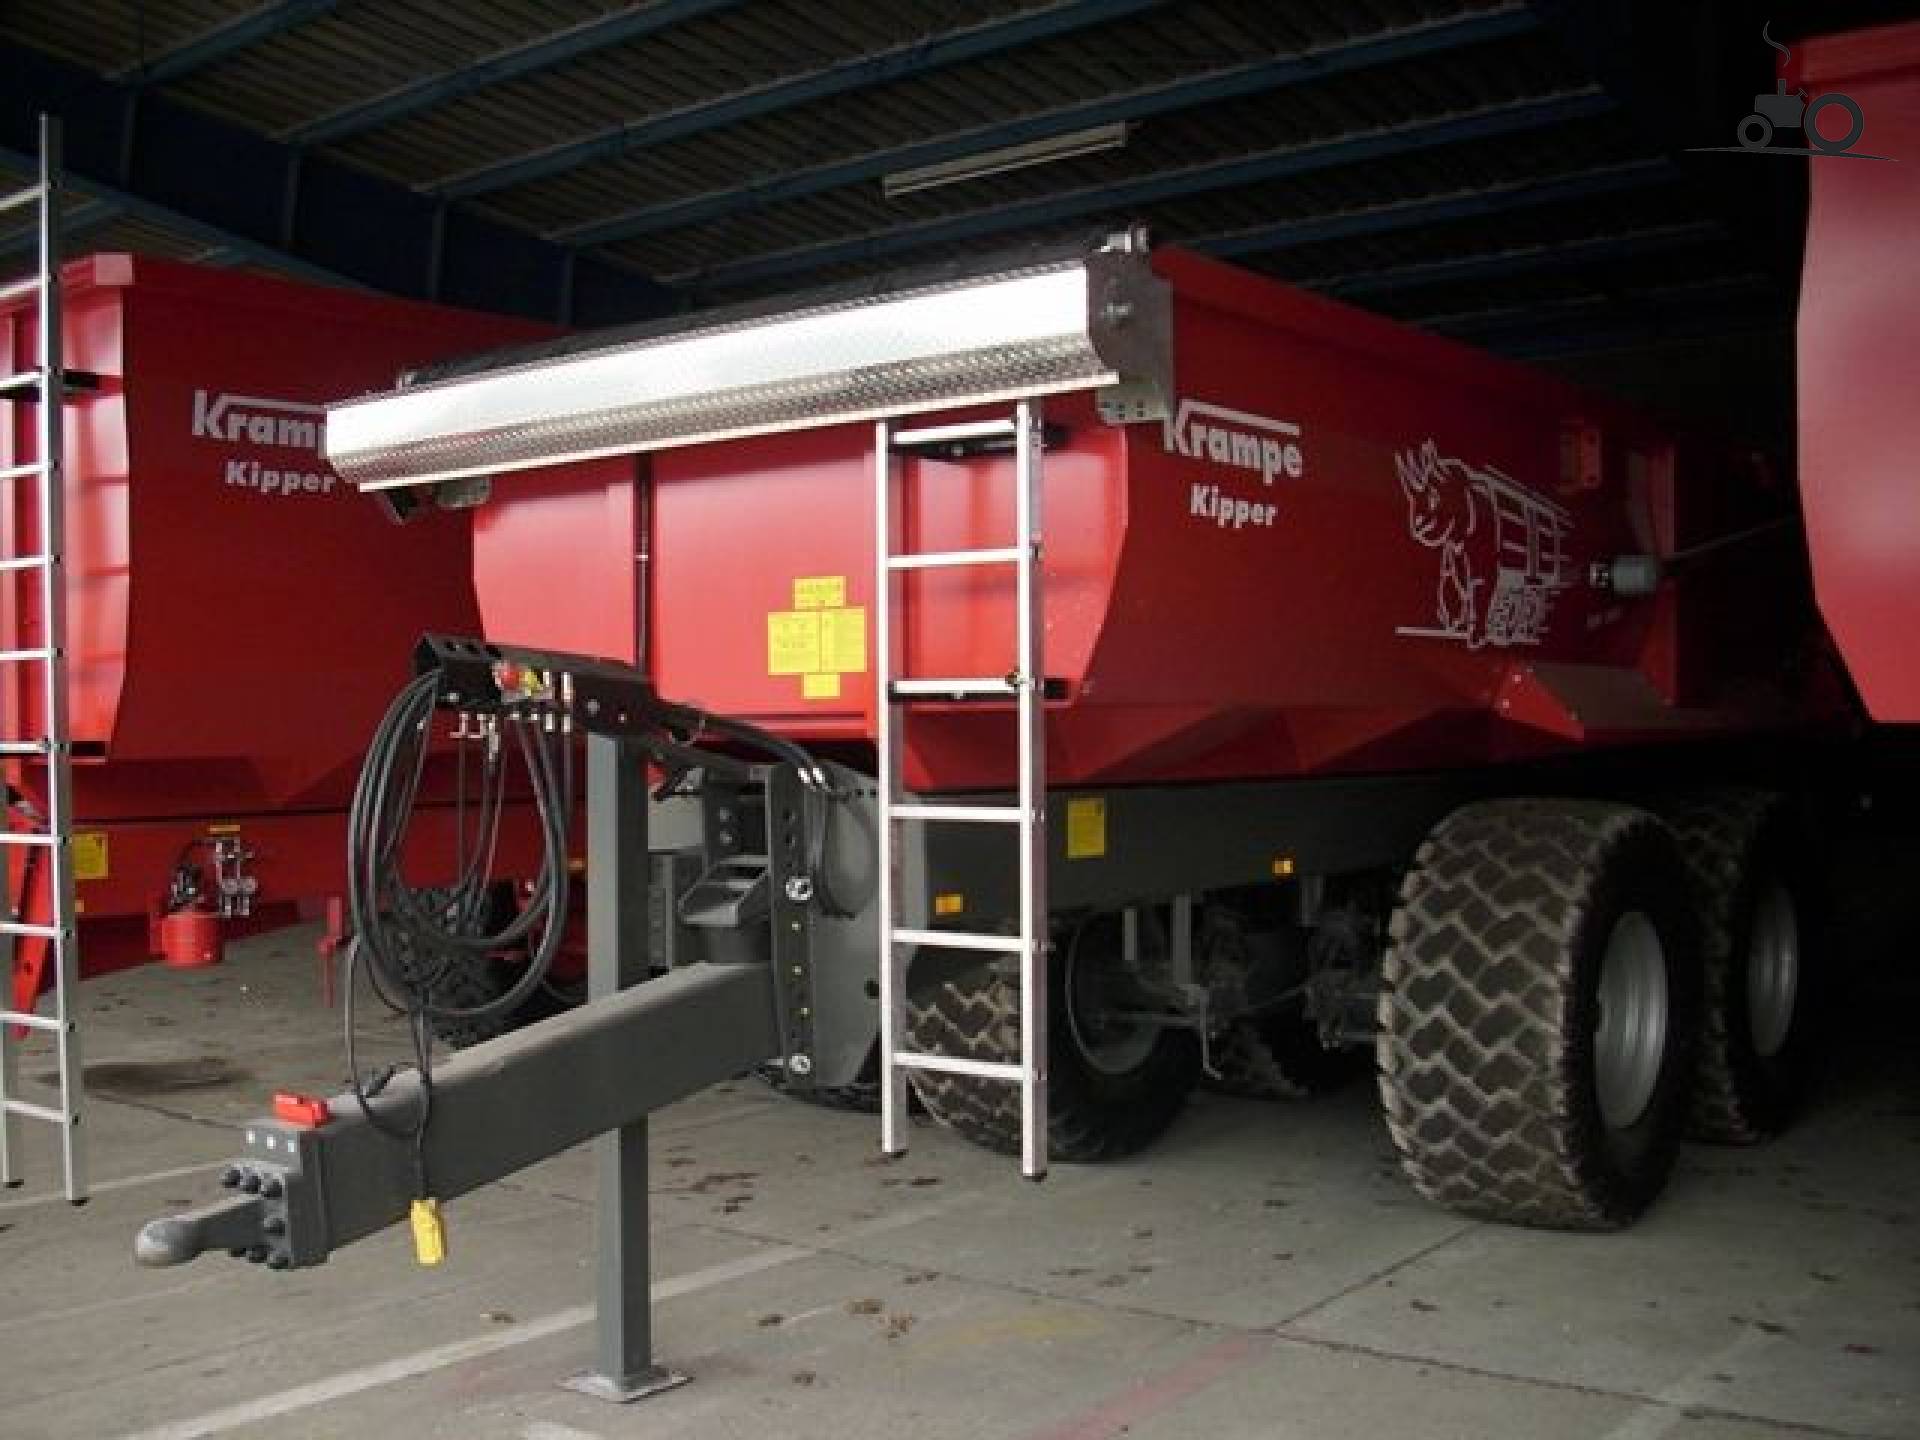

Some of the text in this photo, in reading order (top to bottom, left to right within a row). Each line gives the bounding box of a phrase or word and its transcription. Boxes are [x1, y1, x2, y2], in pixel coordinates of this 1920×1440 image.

[1163, 399, 1303, 486] Krampe
[226, 460, 337, 495] Kipper
[1189, 483, 1277, 528] Kipper
